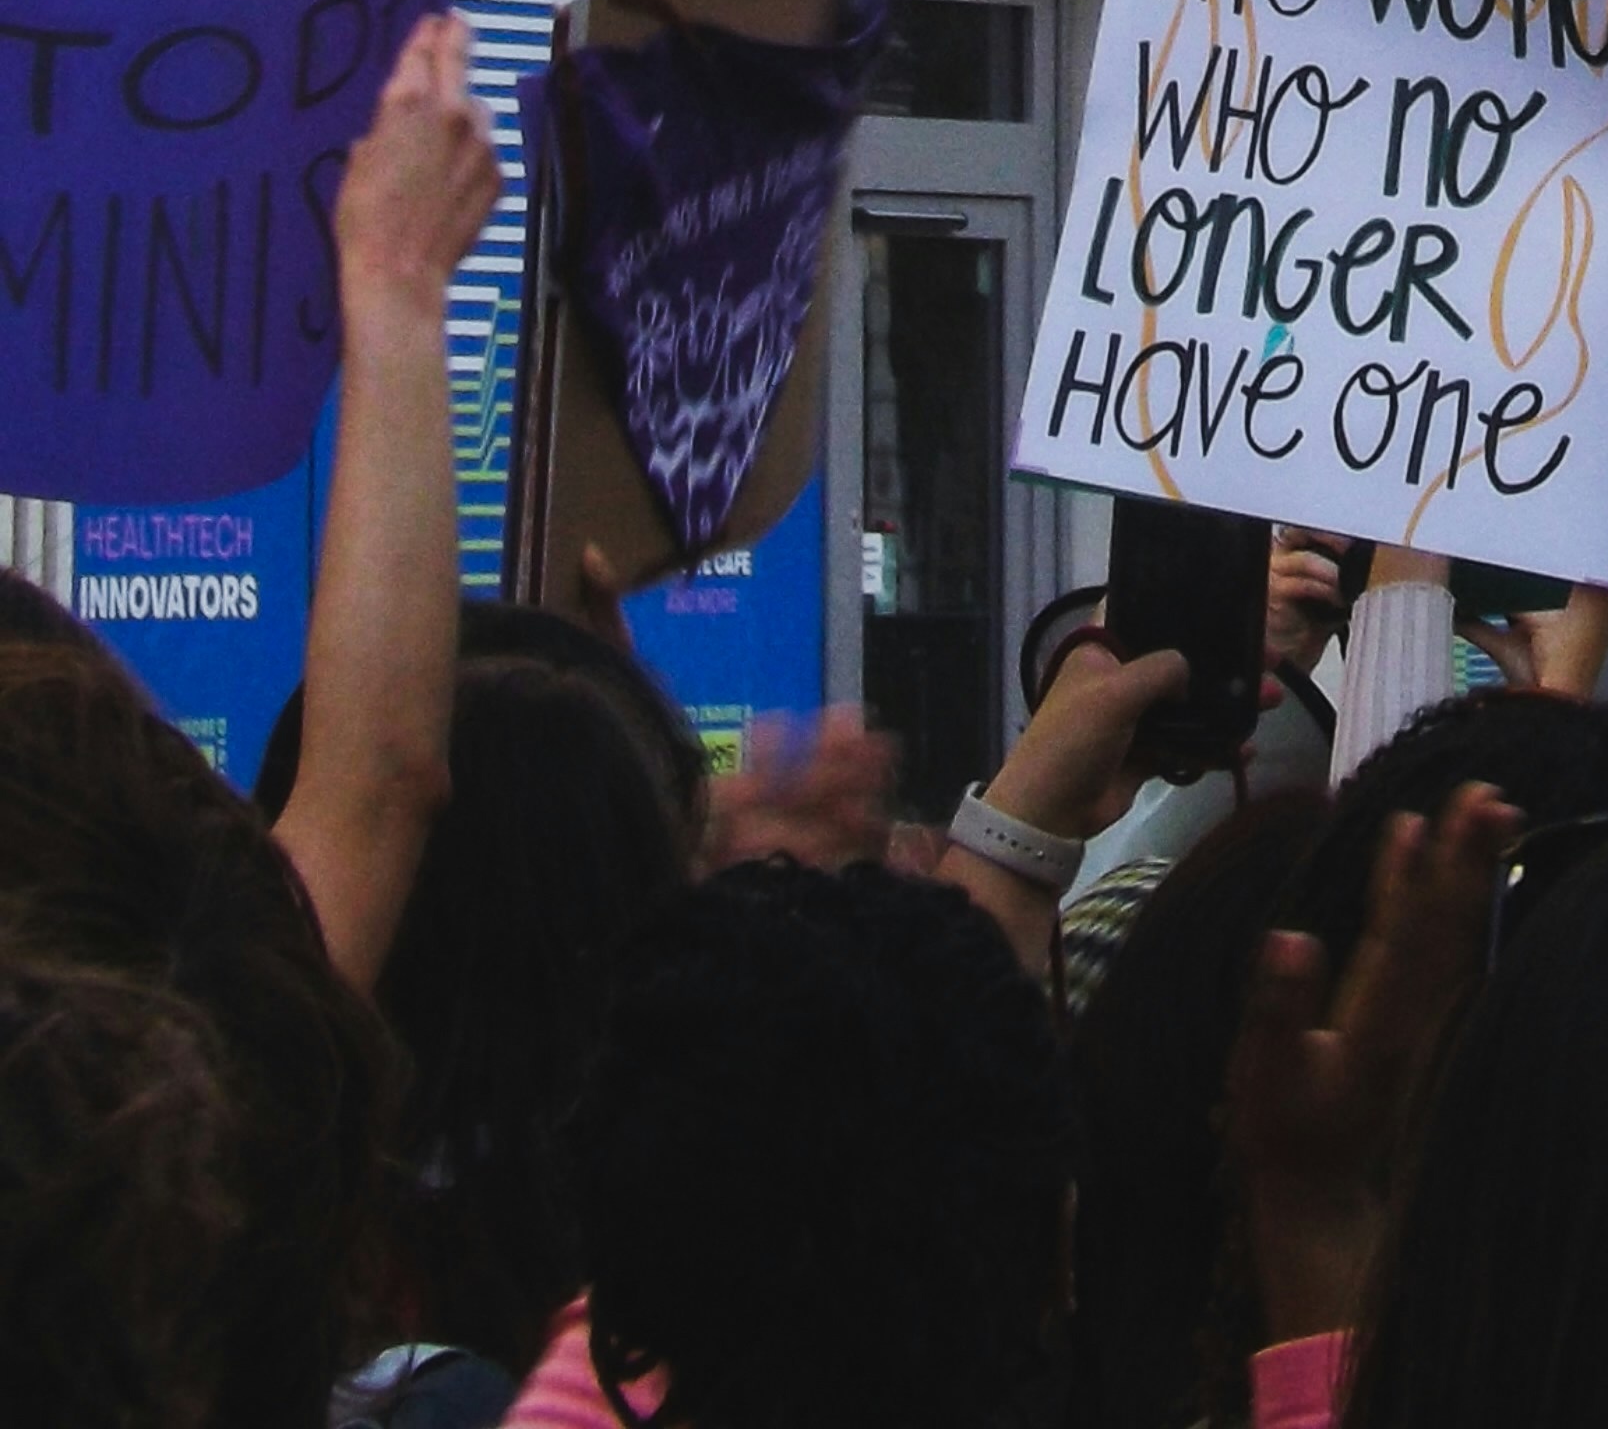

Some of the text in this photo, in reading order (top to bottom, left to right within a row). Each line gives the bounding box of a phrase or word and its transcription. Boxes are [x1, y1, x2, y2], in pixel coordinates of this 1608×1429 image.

[84, 515, 253, 559] HEALTHTECH
[713, 550, 753, 577] CAFE
[79, 574, 257, 620] INNOVATORS
